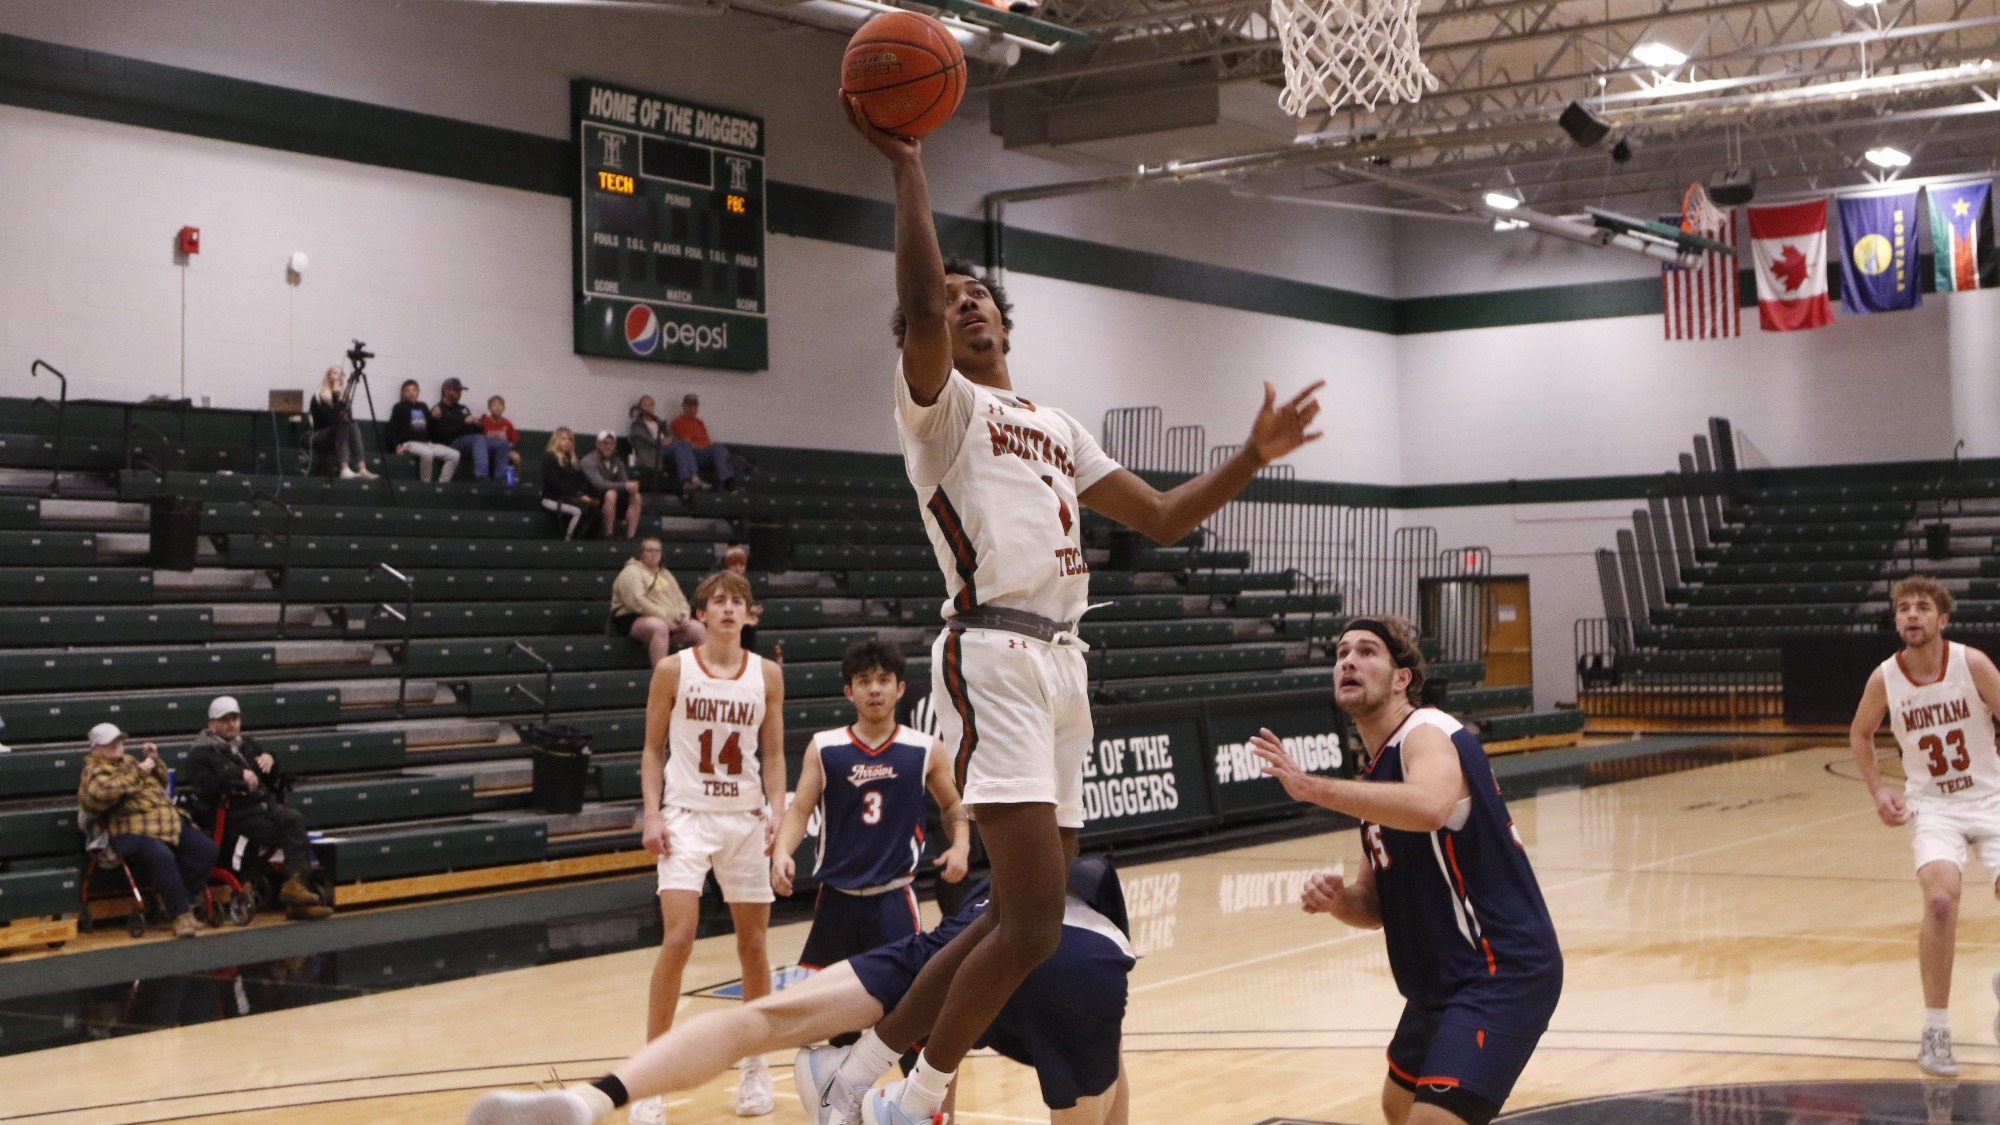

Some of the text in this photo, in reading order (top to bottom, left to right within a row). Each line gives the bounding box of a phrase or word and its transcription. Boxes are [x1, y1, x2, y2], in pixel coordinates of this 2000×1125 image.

[589, 86, 759, 149] HOME OF THE DIGGERS
[598, 171, 635, 195] TECH
[665, 193, 692, 208] PERIOD
[594, 231, 619, 247] FOULS
[653, 241, 682, 256] PLAYER
[684, 246, 703, 260] FOUL
[735, 254, 758, 268] FOULS
[1893, 209, 1906, 292] MONTANA
[594, 279, 619, 294] SCORE
[666, 289, 692, 303] MATCH
[736, 297, 758, 312] SCORE
[662, 321, 728, 353] pepsi
[1902, 698, 1971, 732] MONTANA
[698, 729, 743, 775] 14
[1099, 739, 1126, 776] OF
[1129, 734, 1173, 772] THE
[1215, 732, 1343, 784] #RODIGGS
[1918, 728, 1971, 777] 33
[703, 780, 739, 797] TECH
[849, 764, 896, 783] Arrows
[1936, 775, 1974, 794] TECH
[863, 790, 882, 825] 3
